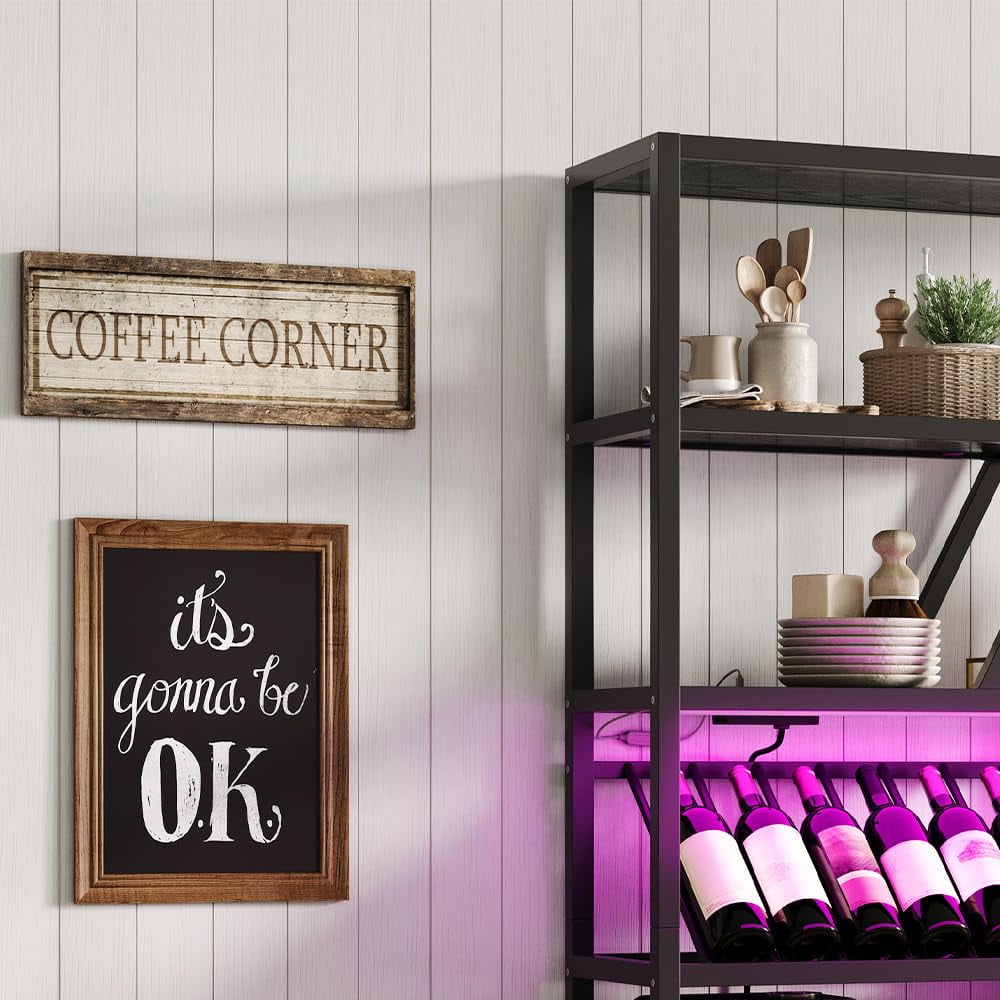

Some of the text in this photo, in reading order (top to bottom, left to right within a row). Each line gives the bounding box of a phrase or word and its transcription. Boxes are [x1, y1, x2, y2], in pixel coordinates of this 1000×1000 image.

[46, 310, 391, 372] COFFEE CORNER
[170, 569, 254, 651] it's
[112, 654, 309, 754] gonna be
